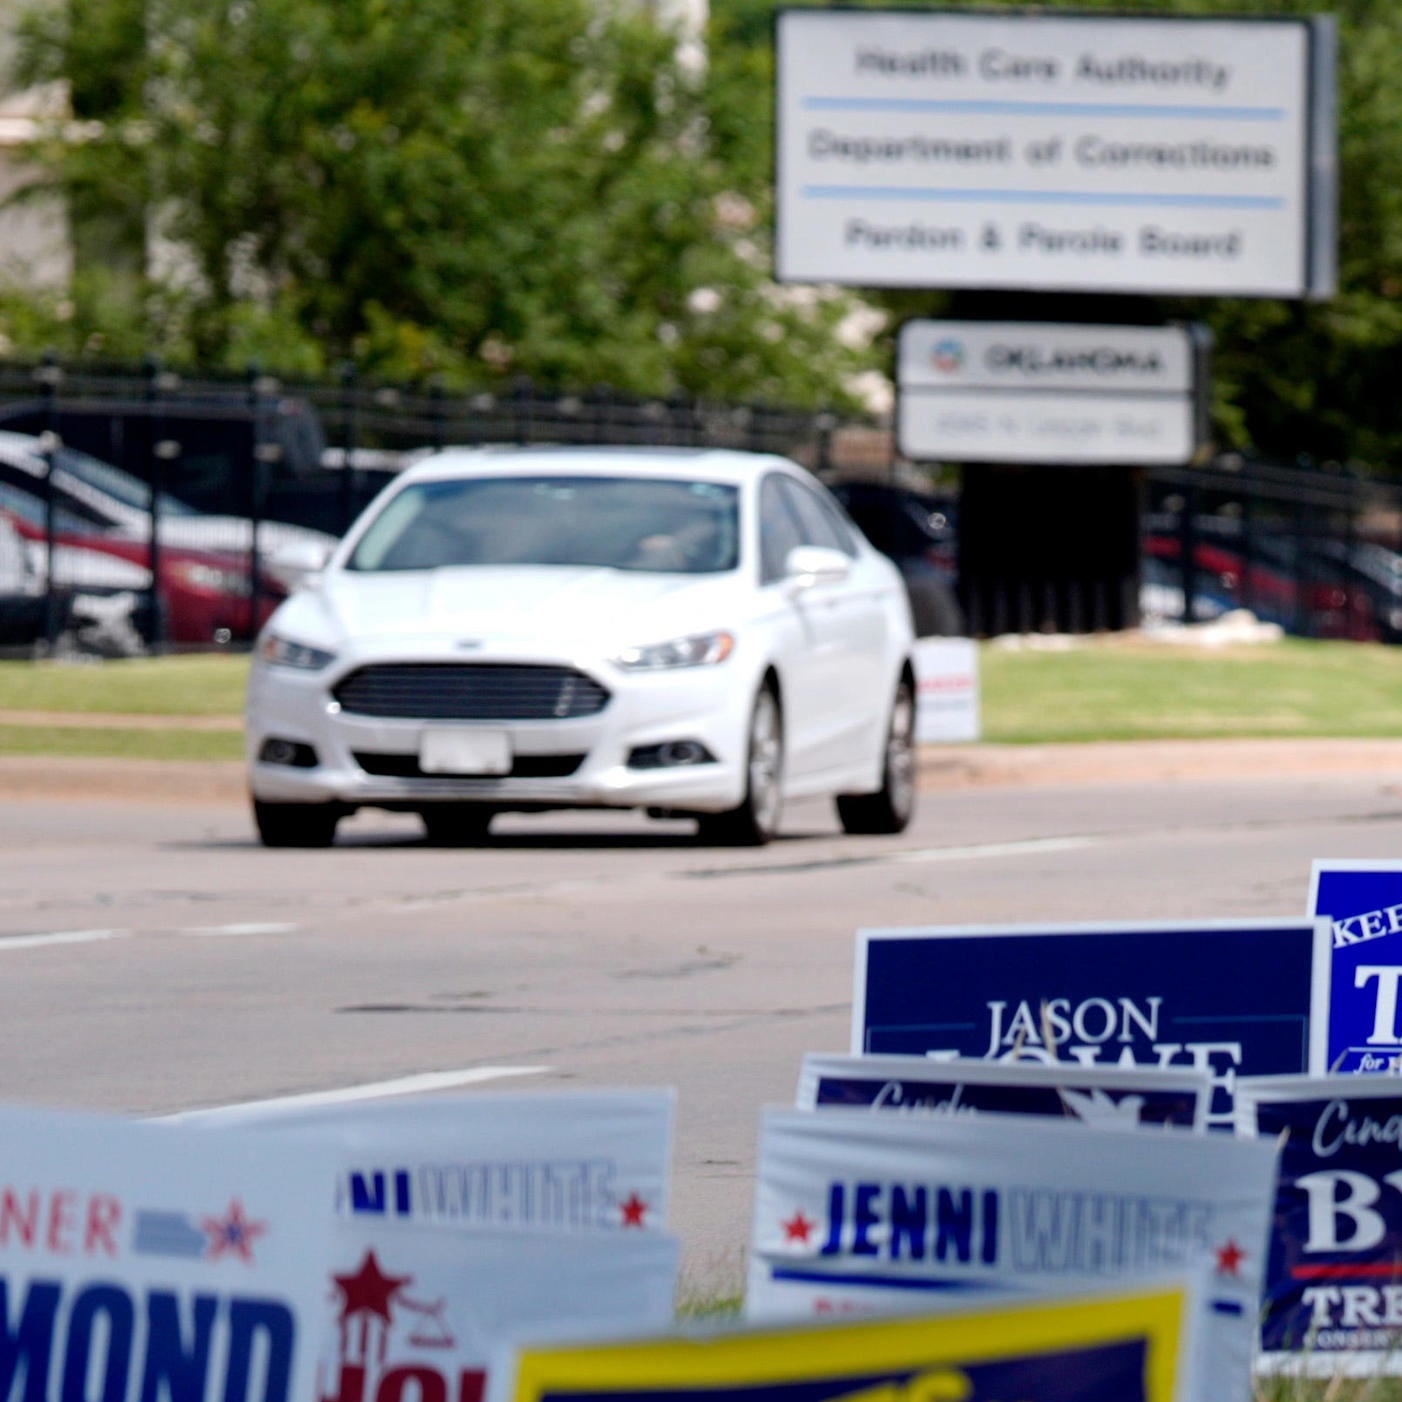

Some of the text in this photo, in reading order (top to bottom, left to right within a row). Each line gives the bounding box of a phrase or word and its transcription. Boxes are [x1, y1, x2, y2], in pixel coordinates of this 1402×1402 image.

[856, 48, 1230, 91] Health Care Authority
[808, 129, 1277, 169] Department of Corrections
[845, 217, 1243, 258] Pardon & Parole Board
[987, 997, 1163, 1060] JASON
[1353, 1052, 1385, 1075] for
[336, 1168, 411, 1216] NI
[821, 1182, 1216, 1274] JENNI WHITE
